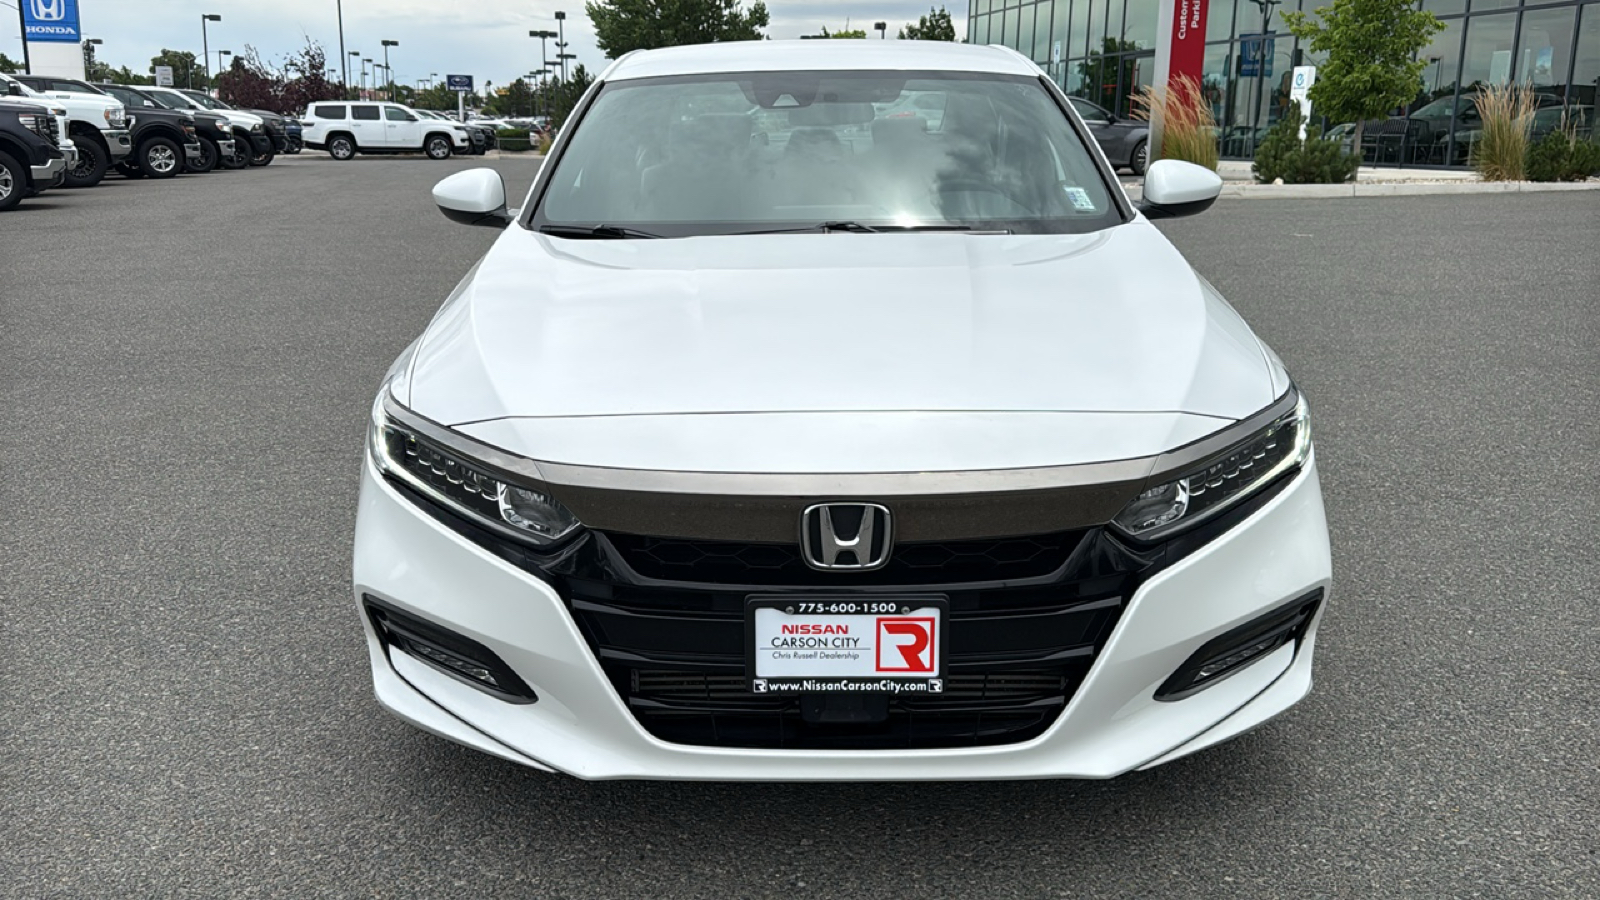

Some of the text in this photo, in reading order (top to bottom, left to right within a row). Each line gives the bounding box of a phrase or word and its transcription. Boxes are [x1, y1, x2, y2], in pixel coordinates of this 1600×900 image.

[25, 25, 77, 35] HONDA
[798, 603, 897, 613] 775-600-1500
[781, 624, 849, 635] NISSAN
[771, 637, 860, 648] CARSON CITY
[772, 651, 860, 661] Chris Russell Dealership
[769, 680, 927, 694] www.NissanCarsonCity.com
